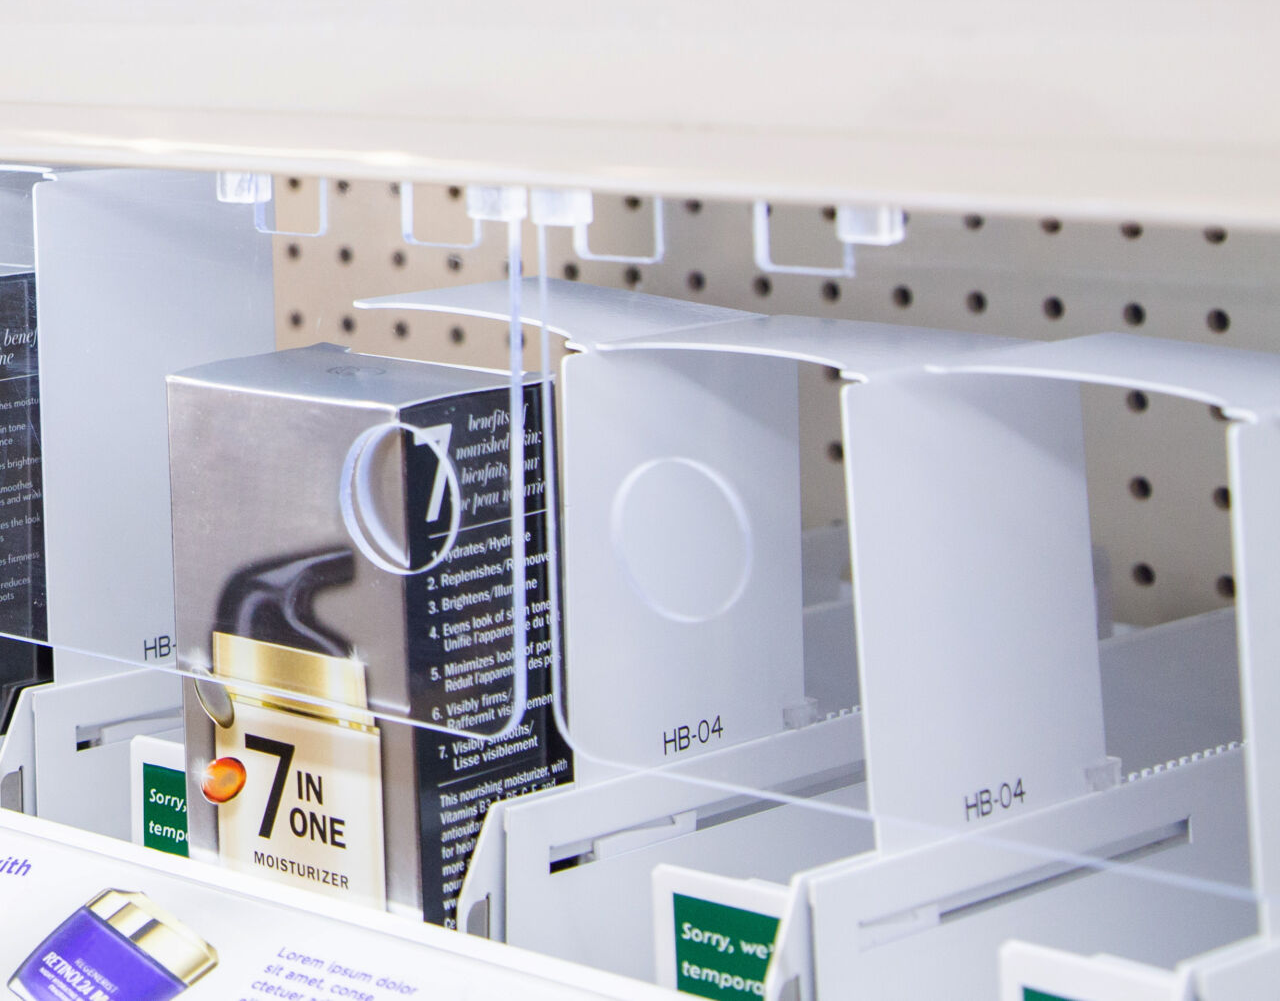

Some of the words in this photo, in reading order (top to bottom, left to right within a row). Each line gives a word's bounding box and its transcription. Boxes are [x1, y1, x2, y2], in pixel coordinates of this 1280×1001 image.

[9, 423, 26, 432] tone
[468, 409, 510, 433] benefits
[456, 432, 510, 461] nourished
[413, 423, 452, 522] 7
[461, 461, 508, 487] bienfaits
[7, 494, 21, 505] and
[472, 490, 500, 515] peau
[11, 518, 24, 528] the
[25, 513, 40, 525] look
[8, 551, 40, 564] firmness
[0, 577, 31, 589] reduces
[427, 577, 438, 591] 2.
[428, 601, 439, 615] 3.
[429, 626, 440, 640] 4.
[442, 621, 471, 637] Evens
[472, 613, 493, 630] look
[495, 610, 505, 623] of
[143, 635, 176, 661] HB-
[443, 636, 472, 652] Unifie
[430, 667, 441, 681] 5.
[444, 654, 495, 678] Minimizes
[444, 675, 474, 693] Réduit
[528, 658, 543, 671] des
[432, 707, 443, 721] 6.
[446, 698, 480, 717] Visibly
[482, 687, 513, 707] firms/
[438, 745, 448, 760] 7.
[452, 737, 486, 755] Visibly
[663, 715, 724, 757] HB-04
[453, 754, 480, 771] Lisse
[482, 735, 538, 762] visiblement
[244, 734, 296, 839] 7
[296, 770, 323, 806] IN
[440, 794, 458, 808] This
[460, 782, 503, 802] nourishing
[504, 766, 550, 787] moisturizer,
[551, 760, 568, 773] with
[149, 788, 187, 813] Sorry,
[964, 778, 1026, 822] HB-04
[289, 807, 347, 850] ONE
[440, 806, 478, 825] Vitamins
[441, 846, 454, 859] for
[254, 850, 349, 890] MOISTURIZER
[442, 860, 465, 876] more
[681, 922, 735, 955] Sorry,
[264, 963, 284, 977] sit
[285, 970, 325, 990] amet,
[277, 947, 325, 968] Lorem
[327, 960, 373, 983] ipsum
[375, 976, 419, 996] dolor
